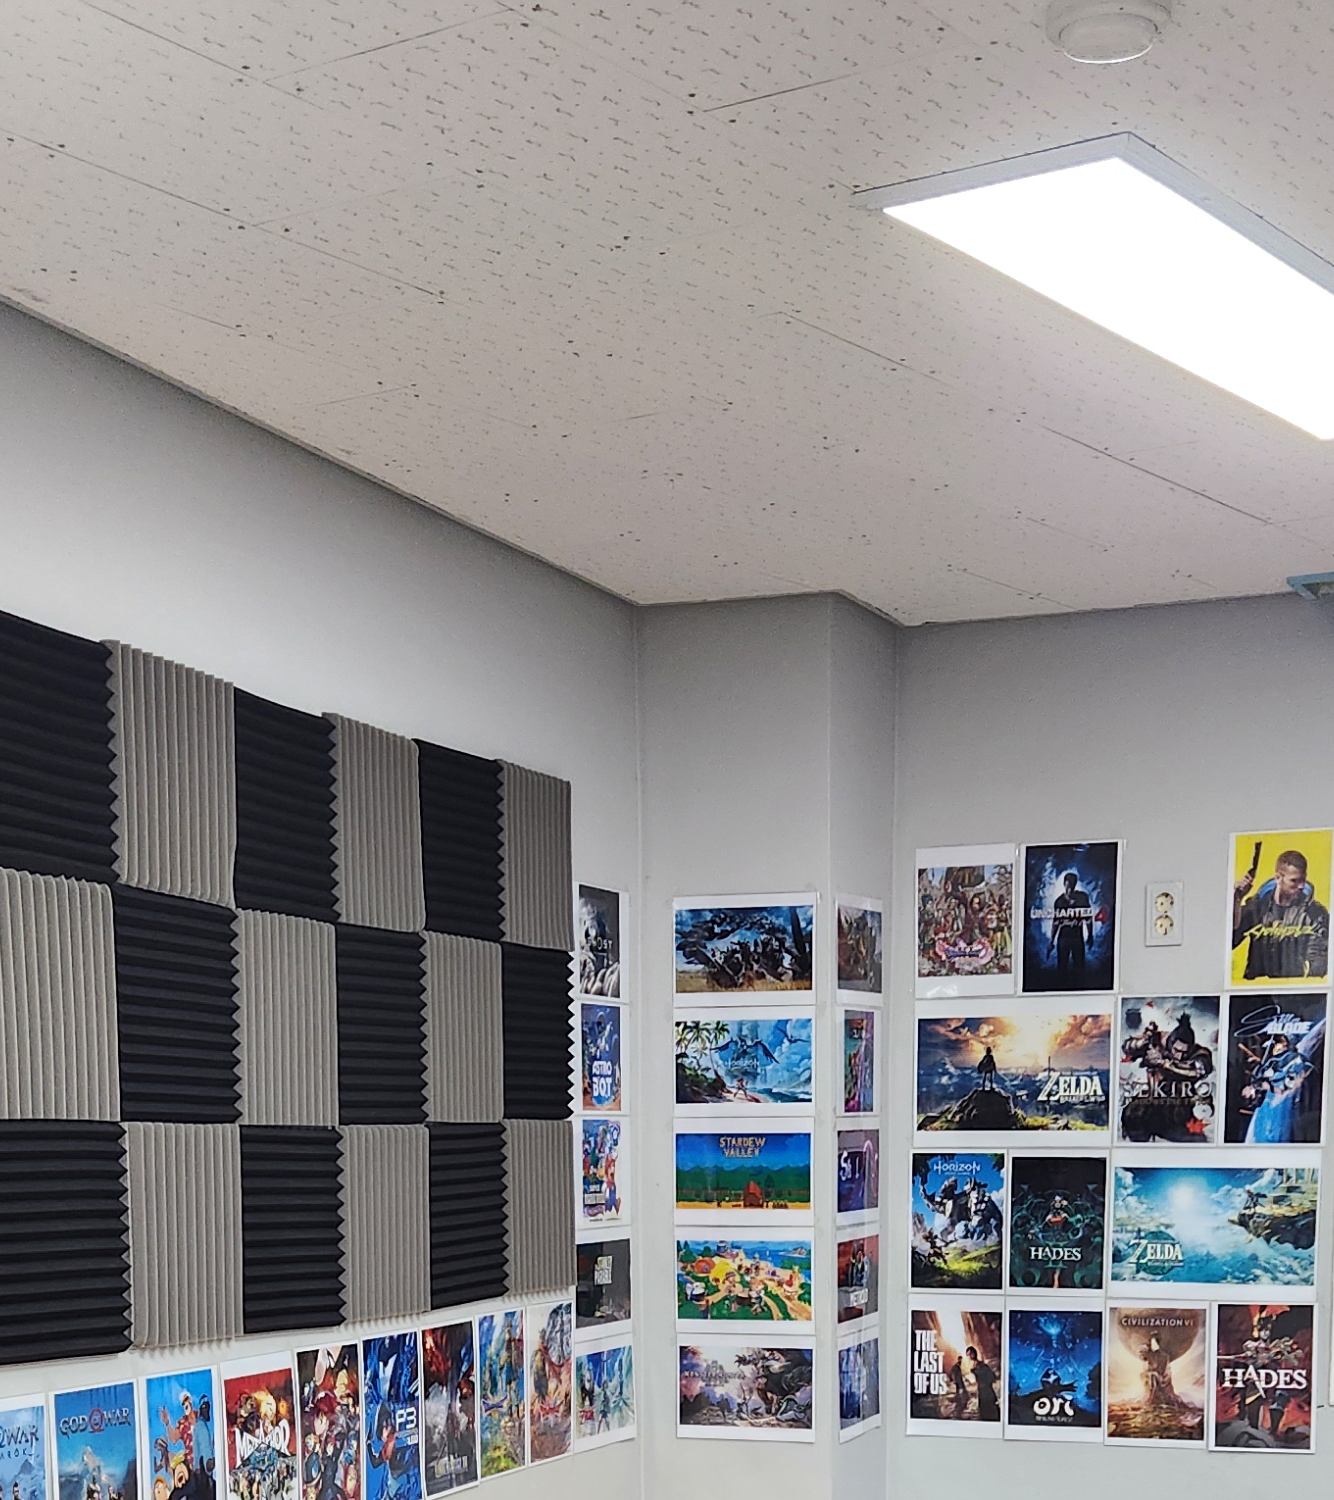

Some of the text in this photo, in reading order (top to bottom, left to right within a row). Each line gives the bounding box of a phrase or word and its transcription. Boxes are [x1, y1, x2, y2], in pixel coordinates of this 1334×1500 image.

[1030, 905, 1094, 919] UNCHARTED
[592, 1060, 613, 1075] ASTRO
[592, 1076, 613, 1097] BOT
[1037, 1071, 1104, 1101] ZELDA
[1123, 1081, 1213, 1098] SEKIRO
[719, 1136, 766, 1148] STARDEW
[723, 1147, 760, 1158] VALLEY
[933, 1160, 981, 1176] HORIZON
[1029, 1246, 1082, 1261] HADES
[1127, 1239, 1184, 1264] ZELDA
[1121, 1318, 1193, 1327] CIVILIZATION VI
[915, 1329, 937, 1351] THE
[913, 1351, 945, 1373] LAST
[913, 1373, 948, 1395] OF US
[1221, 1365, 1307, 1397] HADES
[60, 1415, 88, 1439] GOD
[103, 1407, 131, 1427] WAR
[4, 1425, 39, 1448] WAR
